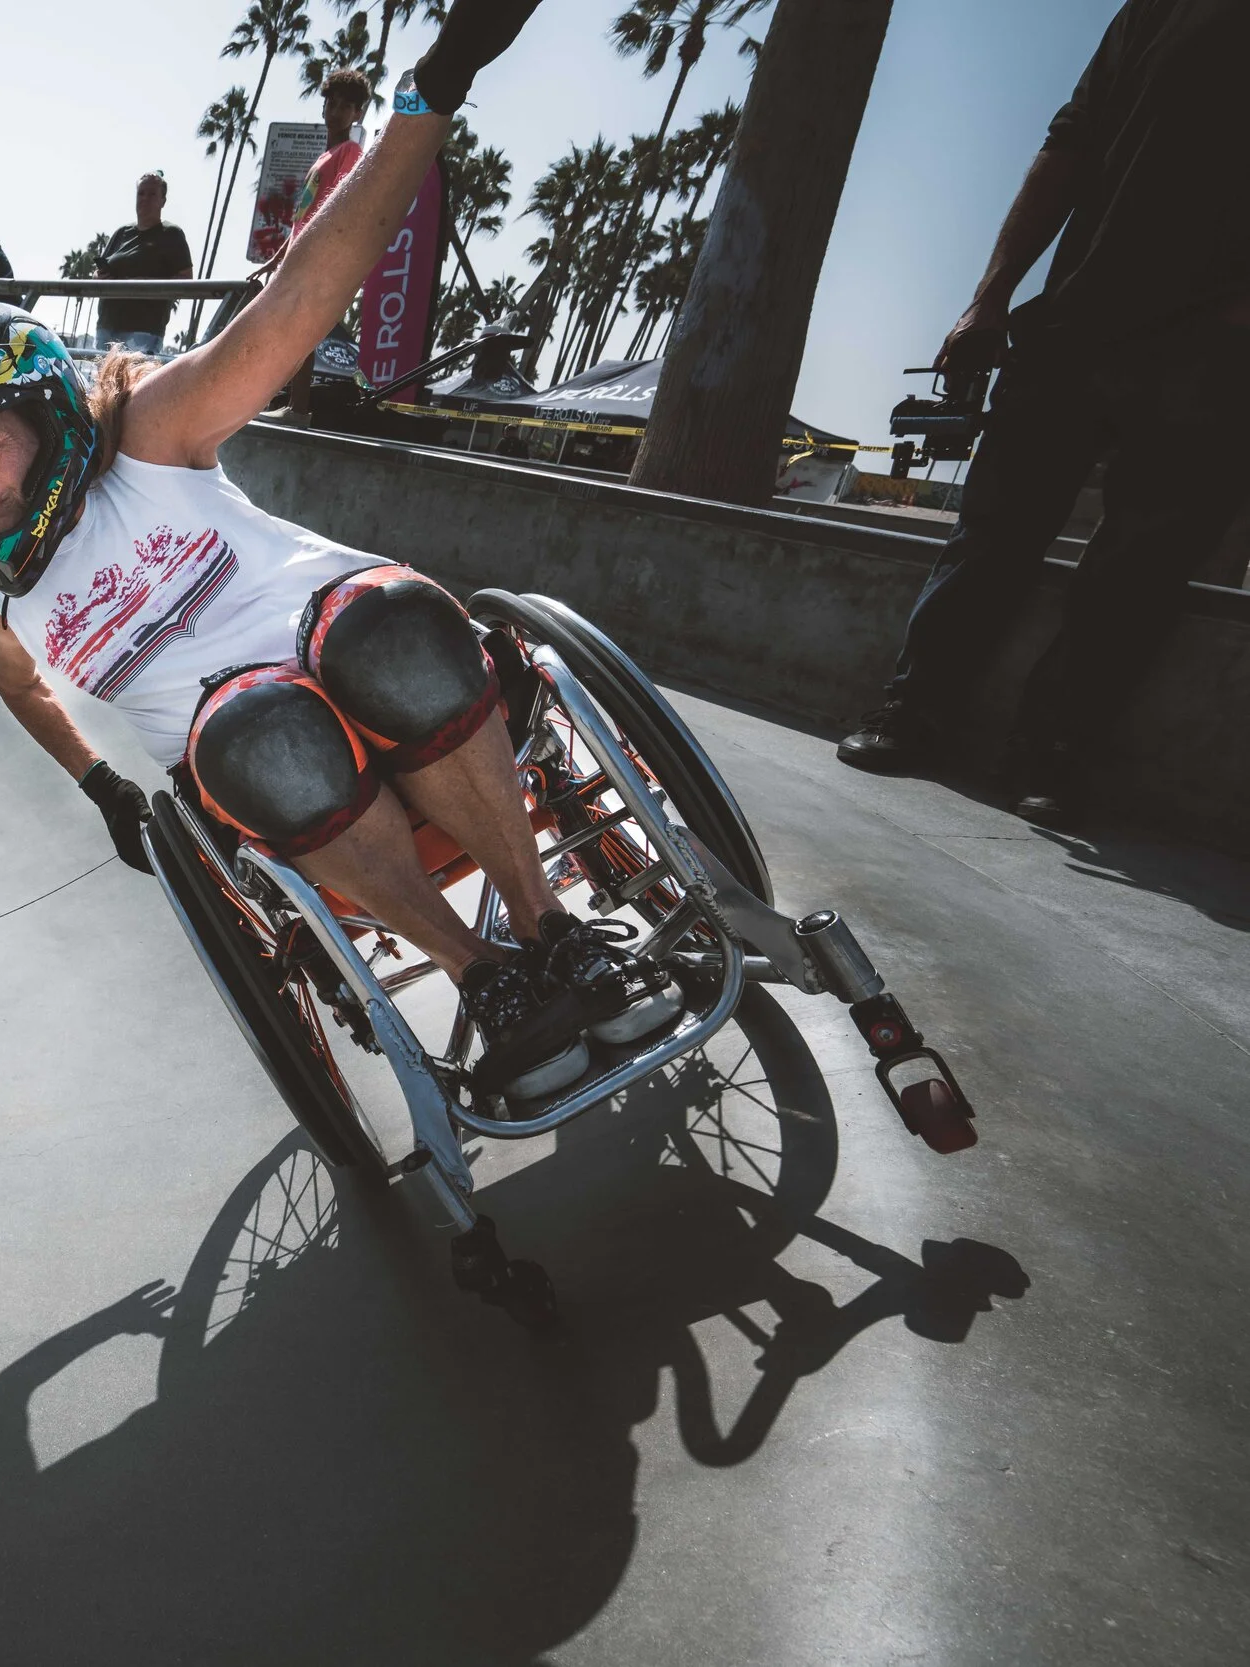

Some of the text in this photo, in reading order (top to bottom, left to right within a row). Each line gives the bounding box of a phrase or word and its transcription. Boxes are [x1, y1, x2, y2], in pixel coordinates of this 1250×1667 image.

[376, 228, 414, 350] ROLLS
[325, 350, 354, 361] ROLLS
[328, 346, 348, 355] LIFE
[580, 384, 657, 401] ROLLS
[463, 402, 479, 411] LIF
[534, 406, 553, 419] LIFE
[553, 407, 583, 421] ROLLS
[43, 480, 64, 517] KALI
